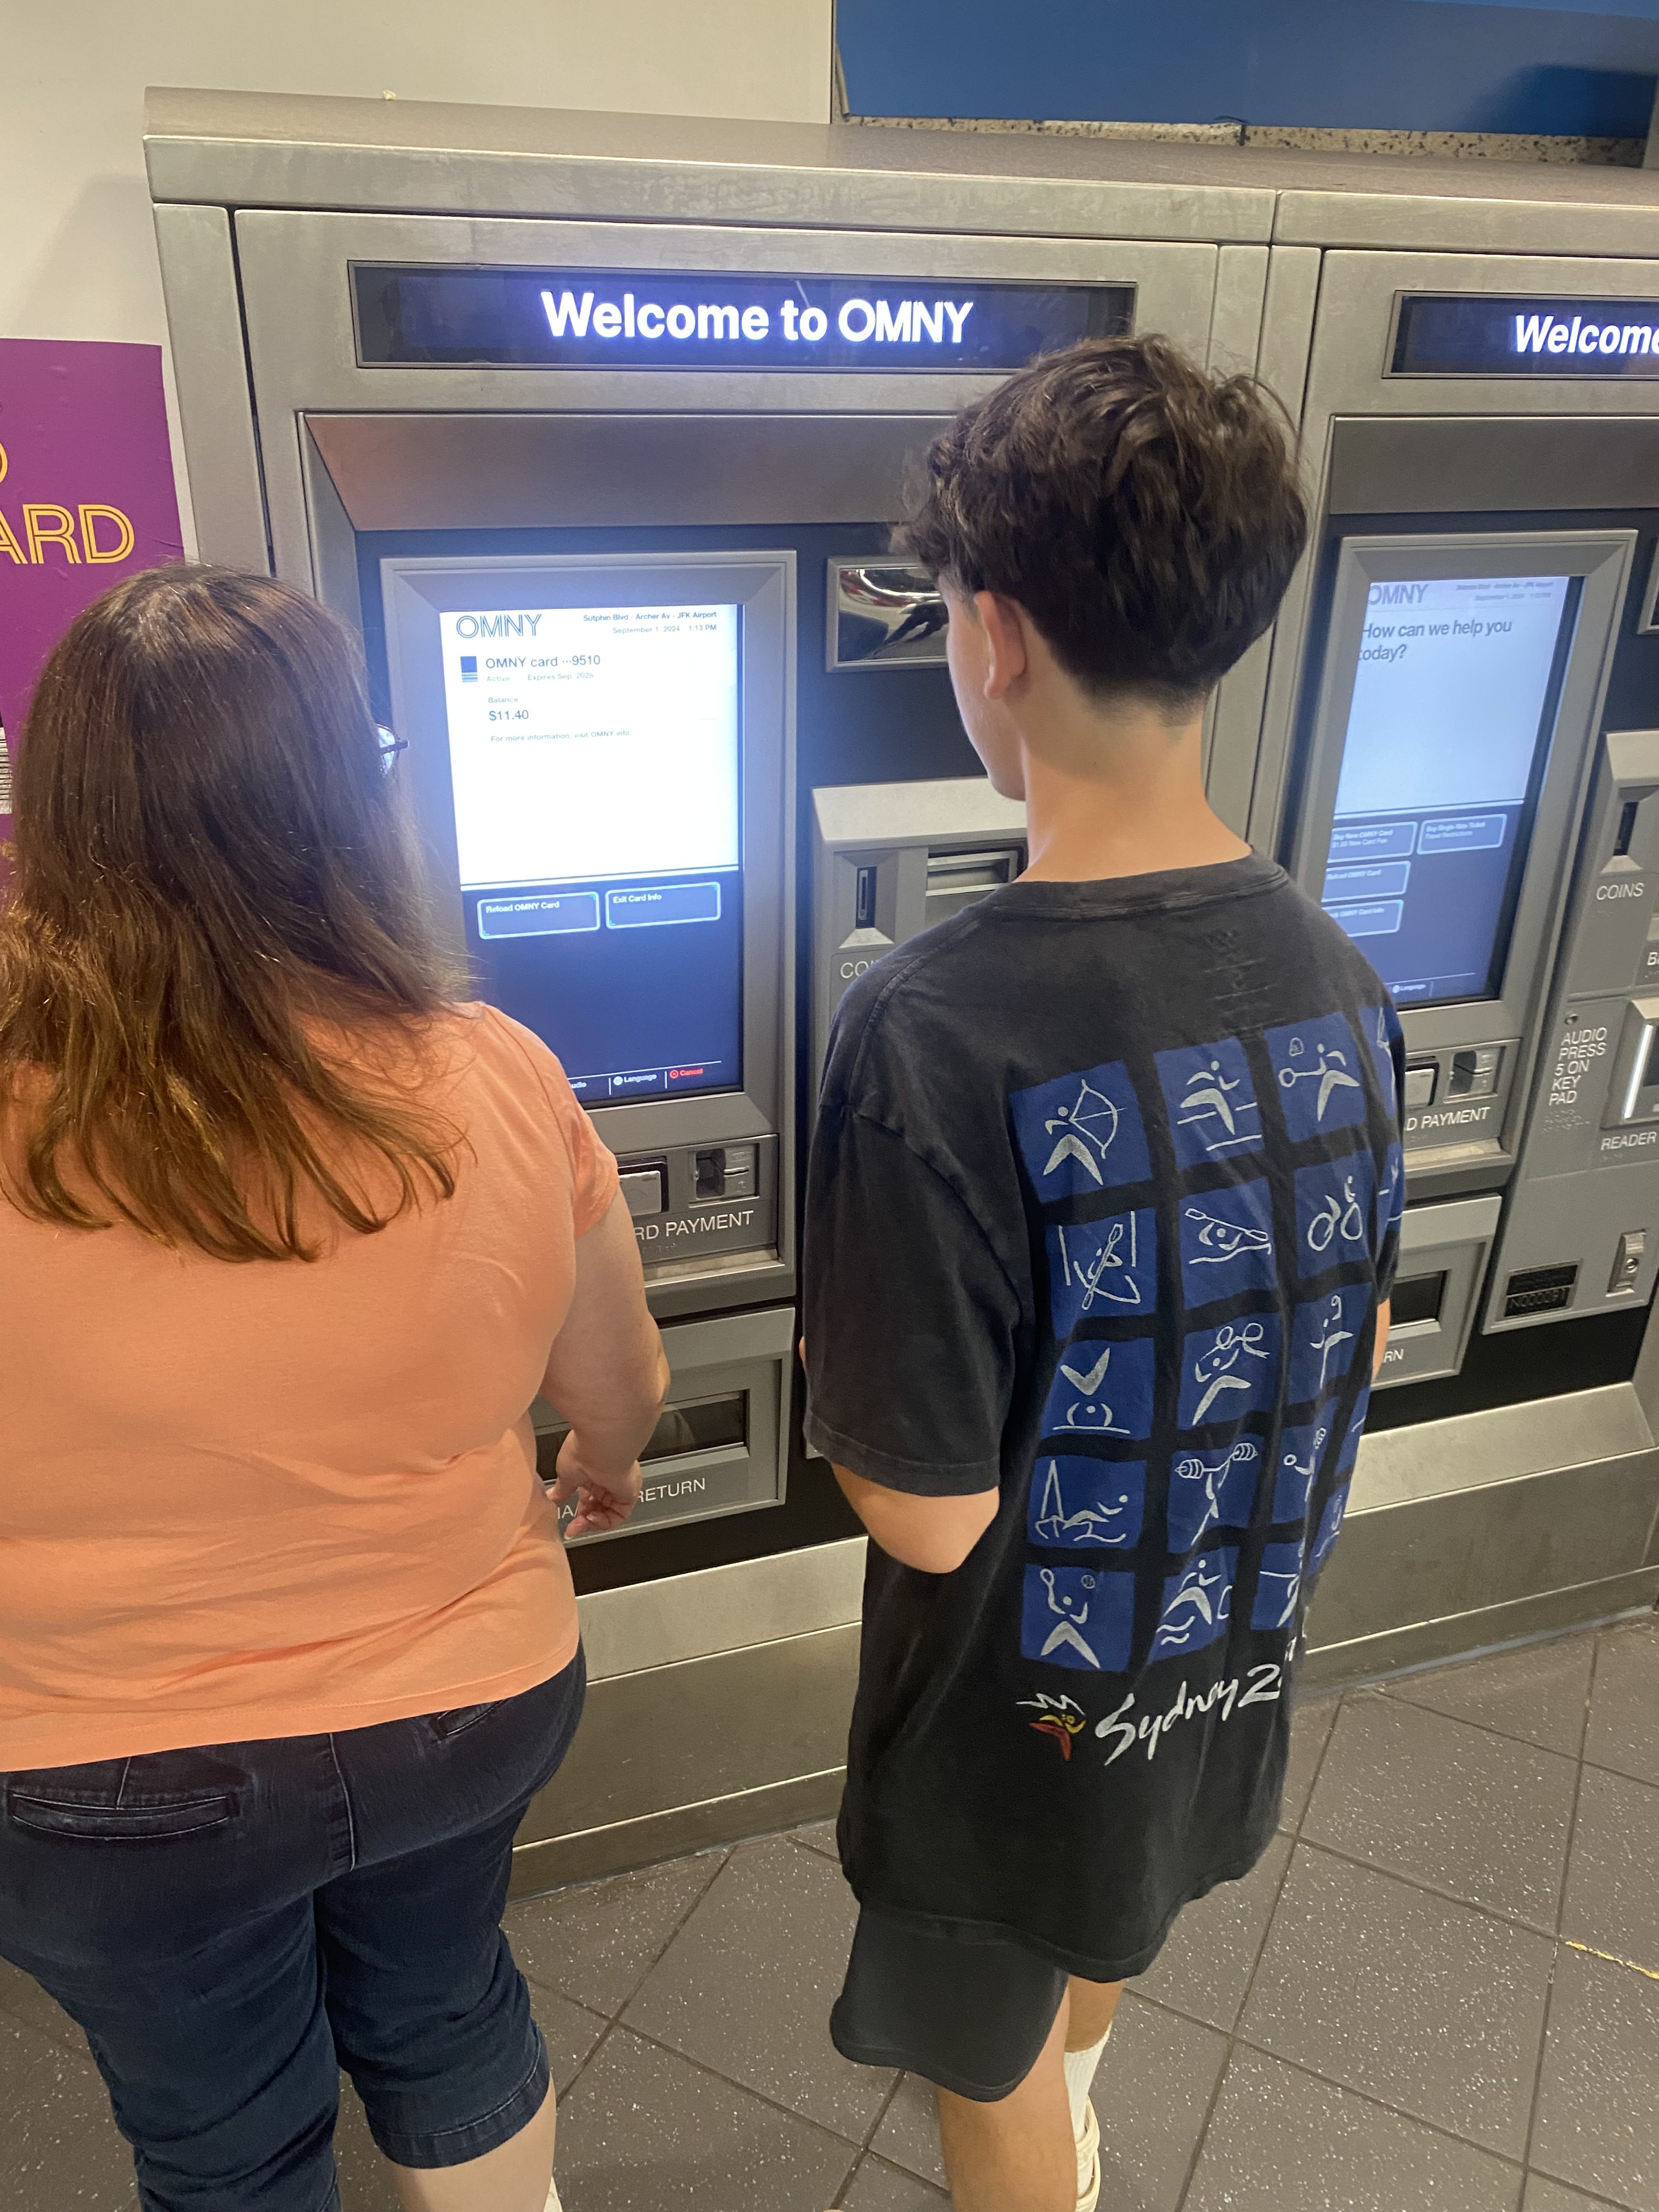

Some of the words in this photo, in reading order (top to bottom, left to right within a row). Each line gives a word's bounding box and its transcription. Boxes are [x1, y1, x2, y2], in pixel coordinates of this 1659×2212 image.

[541, 291, 768, 340] Welcome
[782, 300, 828, 342] to
[839, 300, 973, 344] OMNY
[1368, 584, 1429, 605] OMNY
[692, 611, 717, 619] Airport
[456, 613, 542, 639] OMNY
[1398, 625, 1424, 637] can
[1429, 624, 1449, 636] we
[1452, 619, 1483, 637] help
[1485, 621, 1512, 636] you
[486, 657, 526, 669] OMNY
[531, 656, 558, 667] card
[489, 709, 529, 721] $11.40
[1596, 882, 1645, 900] COINS
[486, 905, 513, 913] Reload
[514, 902, 539, 911] OMNY
[840, 960, 874, 978] CO
[1561, 1027, 1607, 1046] AUDIO
[1559, 1042, 1607, 1060] PRESS
[1554, 1063, 1565, 1076] 5
[1567, 1059, 1590, 1075] ON
[624, 1074, 657, 1083] Language
[1551, 1075, 1582, 1091] KEY
[1548, 1091, 1577, 1106] PAD
[1406, 1118, 1418, 1131] D
[1421, 1106, 1492, 1129] PAYMENT
[1601, 1131, 1657, 1151] READER
[634, 1224, 659, 1240] RD
[665, 1210, 754, 1237] PAYMENT
[1383, 1348, 1404, 1363] RN
[637, 1477, 706, 1503] RETURN
[1095, 1679, 1239, 1766] Sydney
